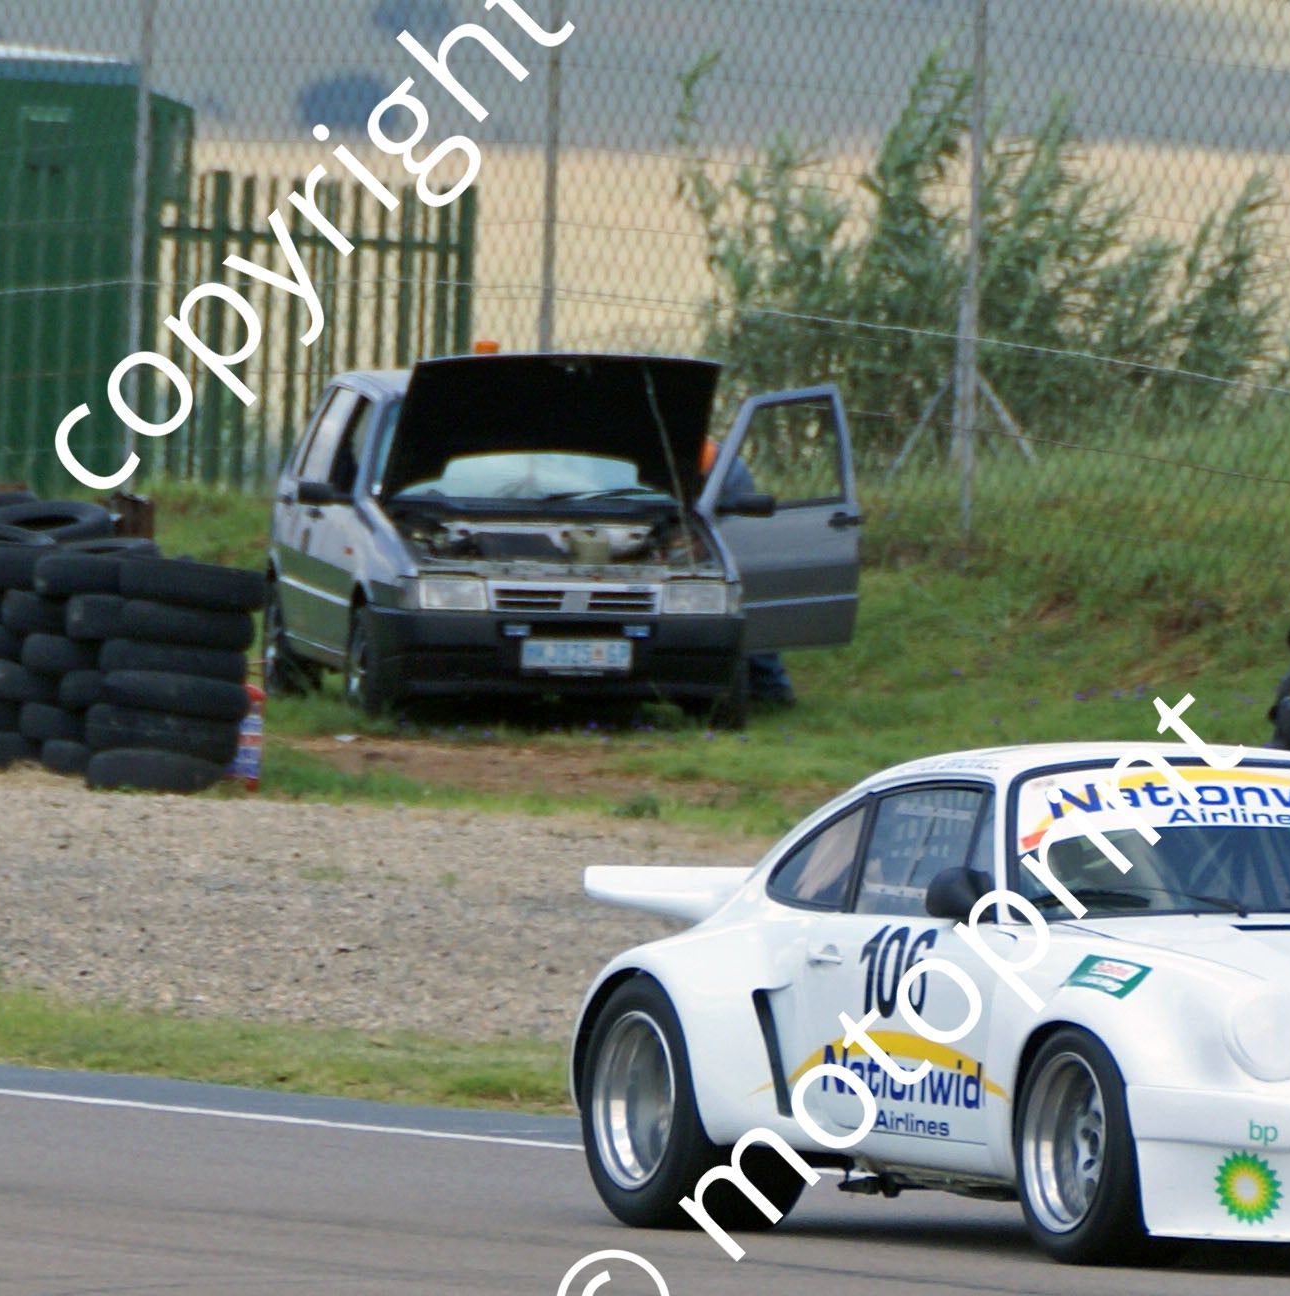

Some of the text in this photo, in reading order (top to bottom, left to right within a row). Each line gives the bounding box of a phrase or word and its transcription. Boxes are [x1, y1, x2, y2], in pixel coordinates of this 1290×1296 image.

[859, 924, 938, 1018] 106
[875, 1108, 950, 1137] Airlines
[1248, 1119, 1279, 1147] bp
